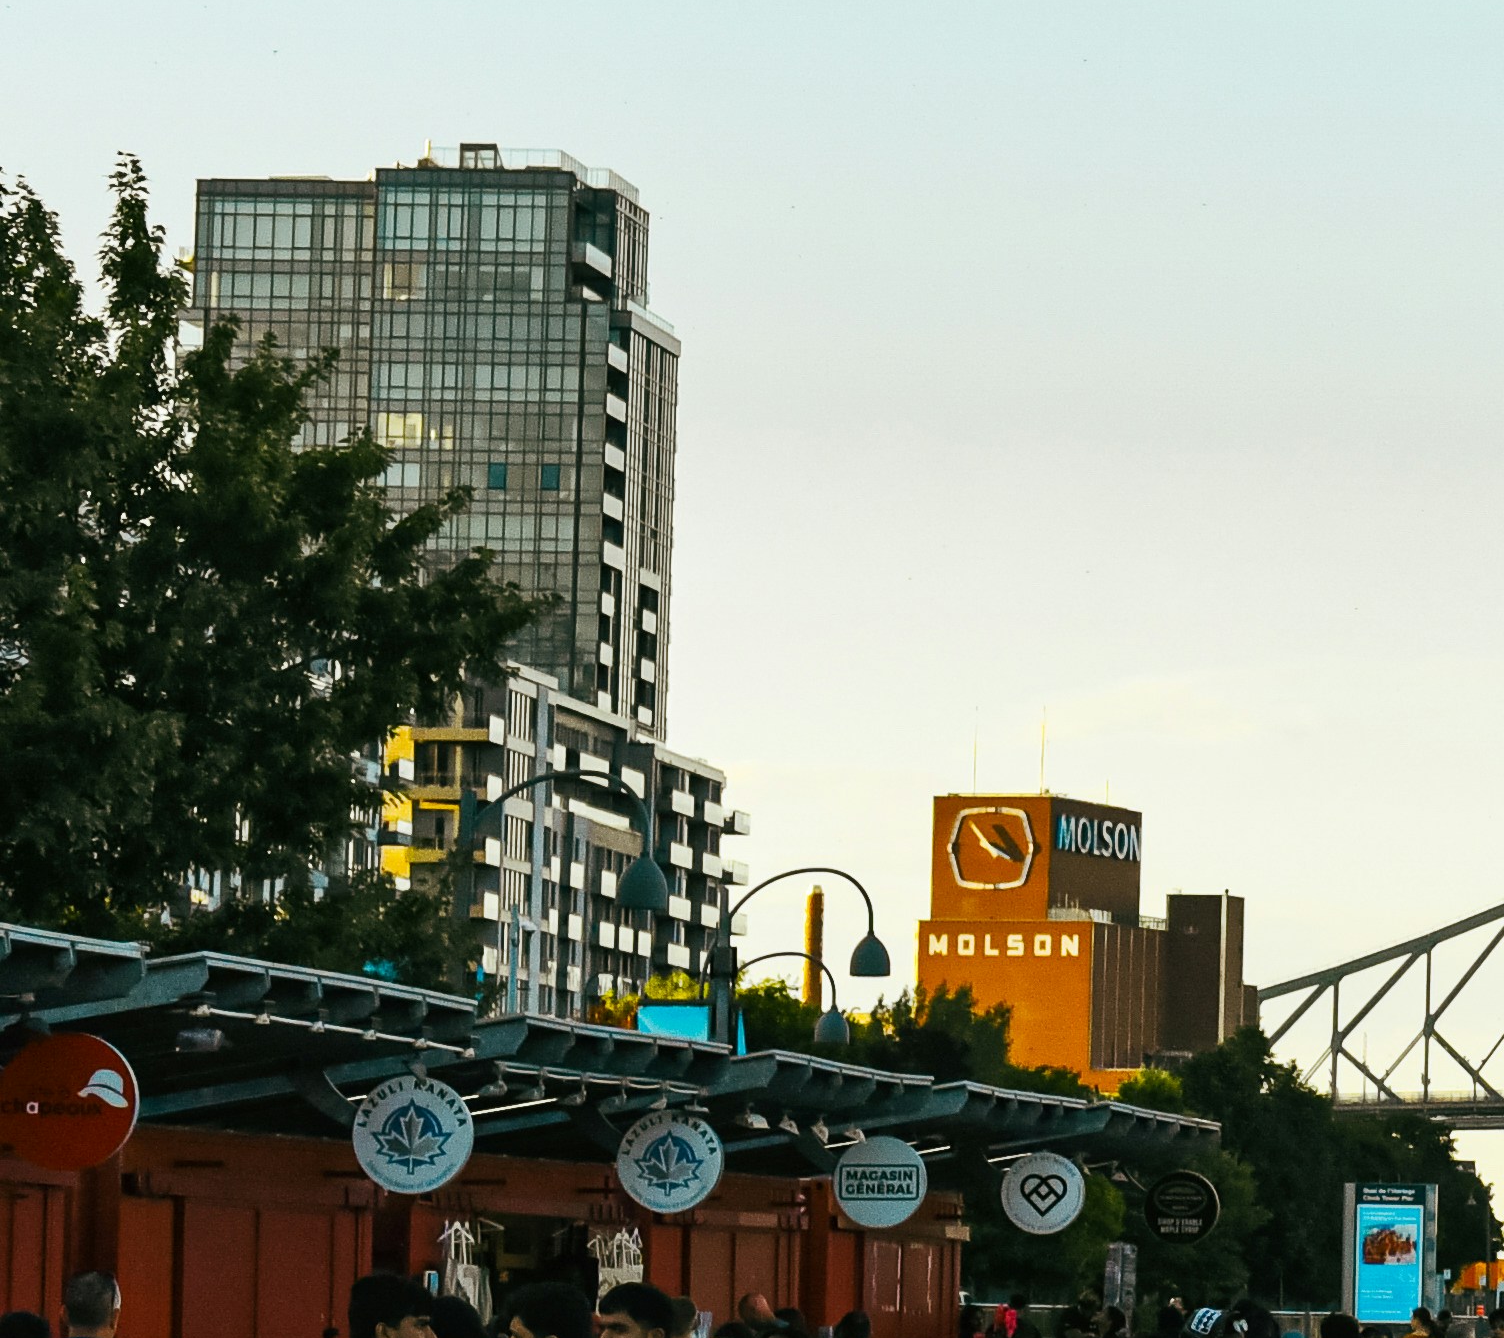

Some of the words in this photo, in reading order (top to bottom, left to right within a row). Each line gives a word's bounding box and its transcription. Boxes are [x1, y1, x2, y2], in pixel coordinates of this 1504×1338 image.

[1058, 813, 1140, 861] MOLSON
[928, 933, 1080, 957] MOLSON
[357, 1081, 404, 1128] LAZULI
[413, 1080, 467, 1128] KANATA
[622, 1115, 663, 1156] LAZULI
[671, 1115, 717, 1156] KANATA
[845, 1170, 914, 1181] MAGASIN
[845, 1181, 914, 1195] GÉNÉRAL
